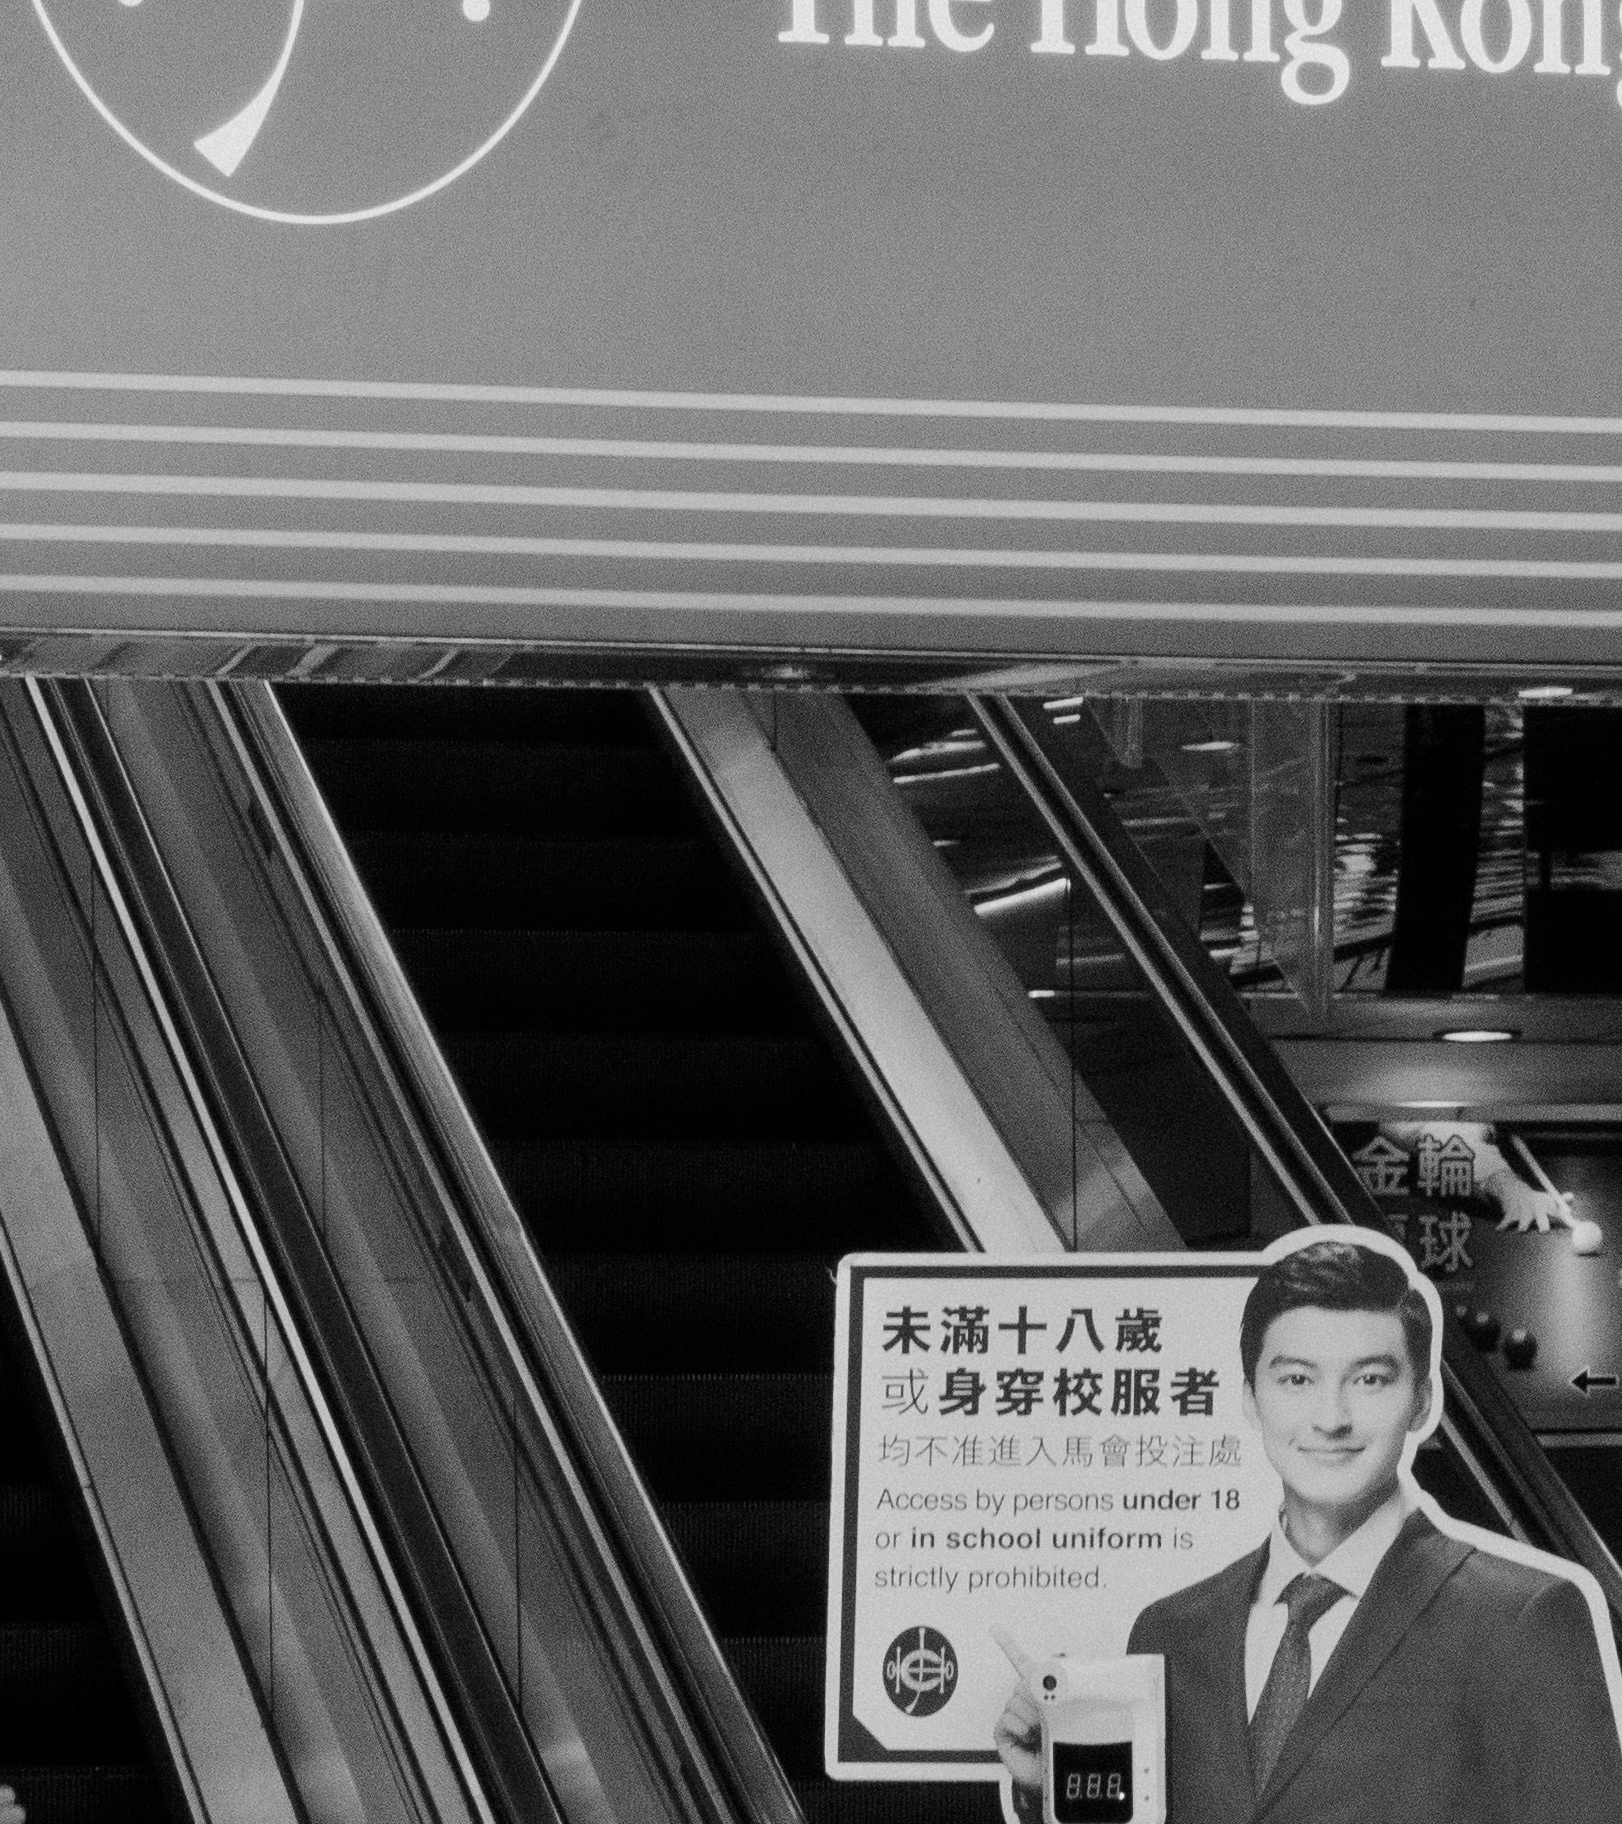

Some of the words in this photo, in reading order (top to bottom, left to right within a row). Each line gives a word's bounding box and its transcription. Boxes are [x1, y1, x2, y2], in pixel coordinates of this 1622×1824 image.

[1352, 1135, 1475, 1196] 金輪
[1388, 1211, 1473, 1272] 球
[882, 1306, 1162, 1354] 未滿十八歲
[882, 1367, 1219, 1416] 或身穿校服者
[879, 1434, 1242, 1467] 均不准進入馬會投注處
[877, 1488, 968, 1511] Access
[976, 1488, 1006, 1516] by
[1013, 1492, 1114, 1516] persons
[1122, 1489, 1201, 1511] under
[1211, 1489, 1240, 1511] 18
[875, 1531, 901, 1549] or
[911, 1527, 935, 1549] in
[945, 1527, 1041, 1549] school
[1051, 1527, 1162, 1549] uniform
[1173, 1527, 1193, 1549] is
[874, 1565, 958, 1593] strictly
[968, 1565, 1107, 1593] prohibited.
